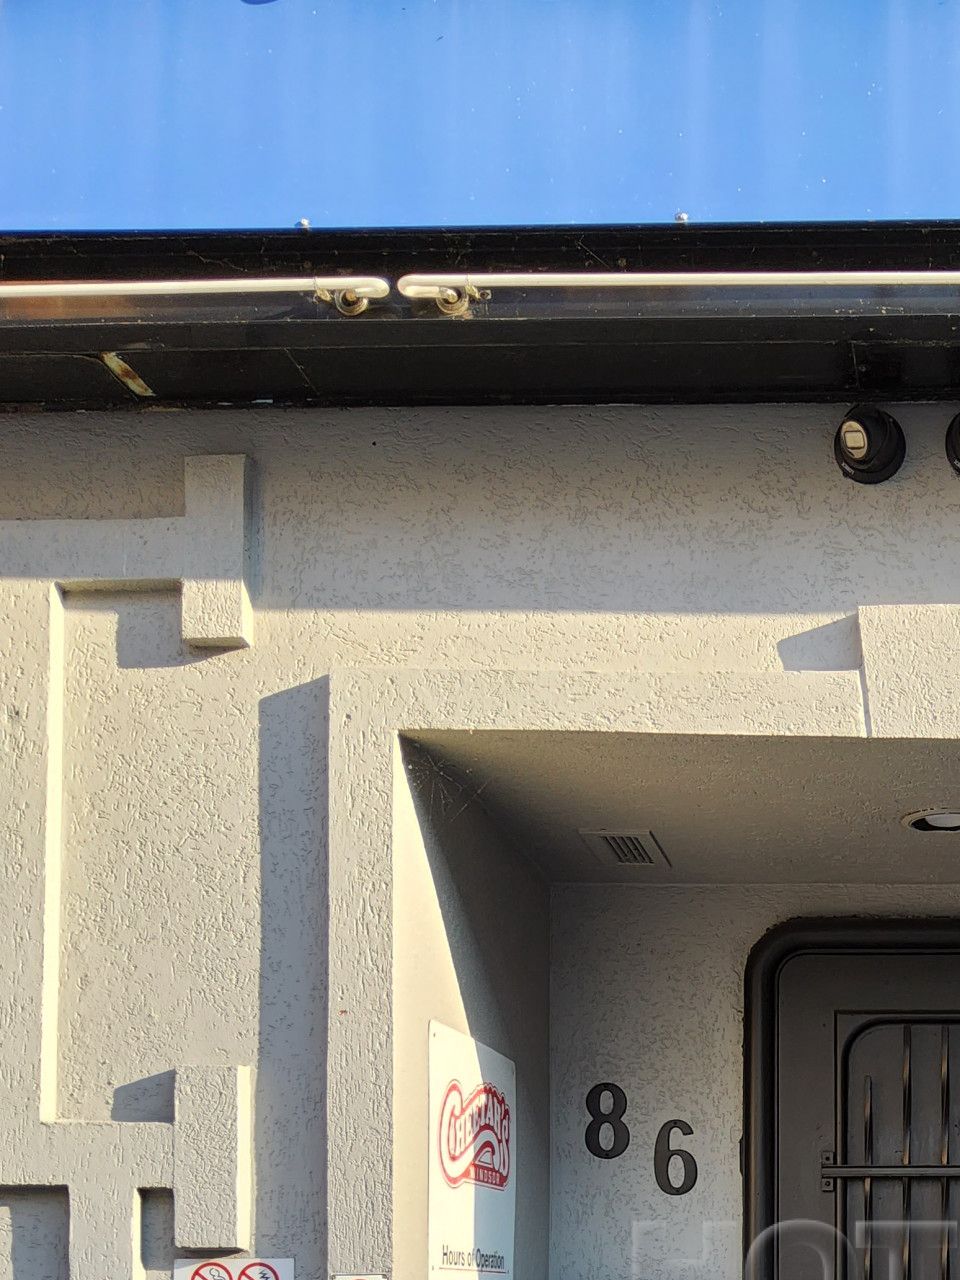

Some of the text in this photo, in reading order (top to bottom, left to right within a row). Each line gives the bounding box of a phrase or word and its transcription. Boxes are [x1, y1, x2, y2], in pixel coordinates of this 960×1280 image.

[440, 1080, 511, 1184] CHEETAH'S
[470, 1166, 500, 1184] WINDSOR
[442, 1244, 505, 1271] Hours of Operation
